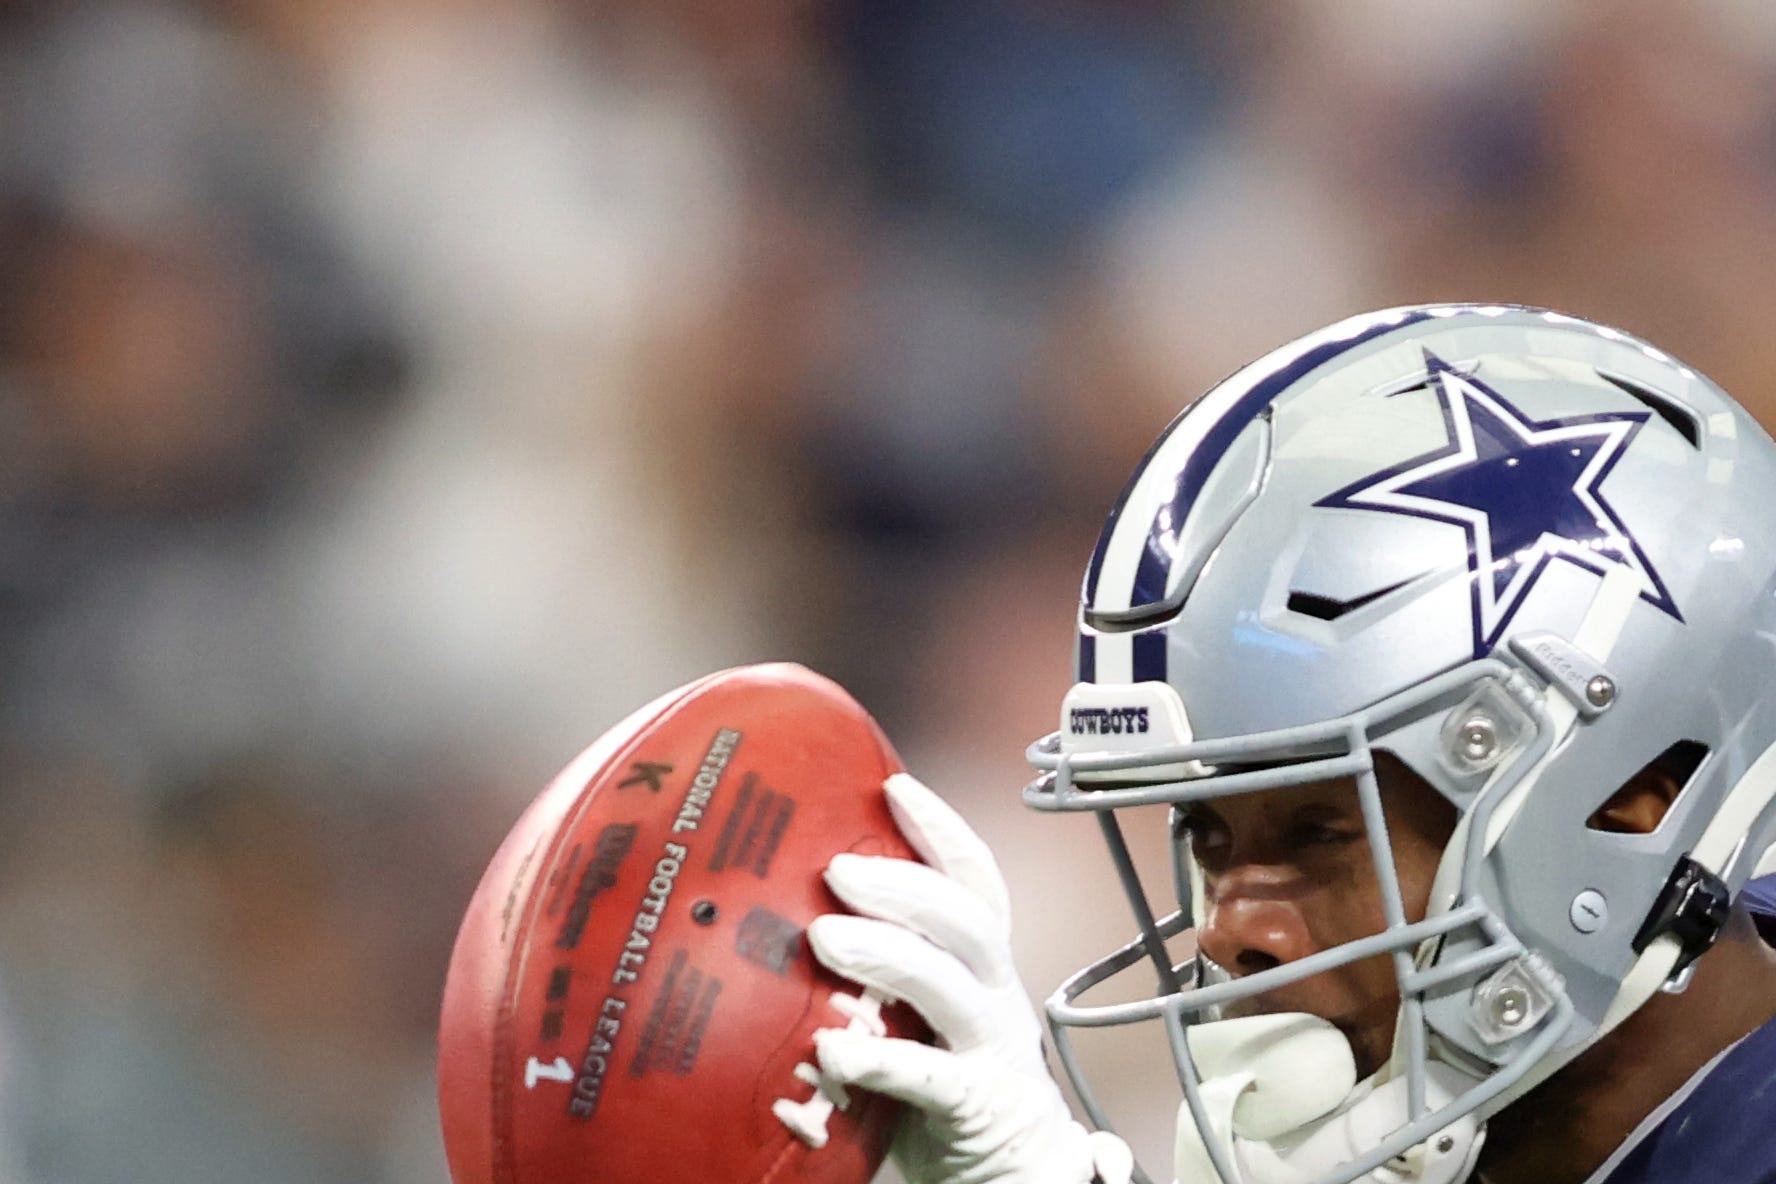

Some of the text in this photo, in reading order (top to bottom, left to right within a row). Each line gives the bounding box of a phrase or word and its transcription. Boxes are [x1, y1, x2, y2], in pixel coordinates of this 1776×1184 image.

[1070, 706, 1149, 735] COWBOYS
[616, 762, 673, 792] K
[671, 729, 742, 834] NATIONAL
[612, 842, 689, 985] FOOTBALL
[524, 1056, 575, 1088] 1
[568, 997, 627, 1121] LEAGUE
